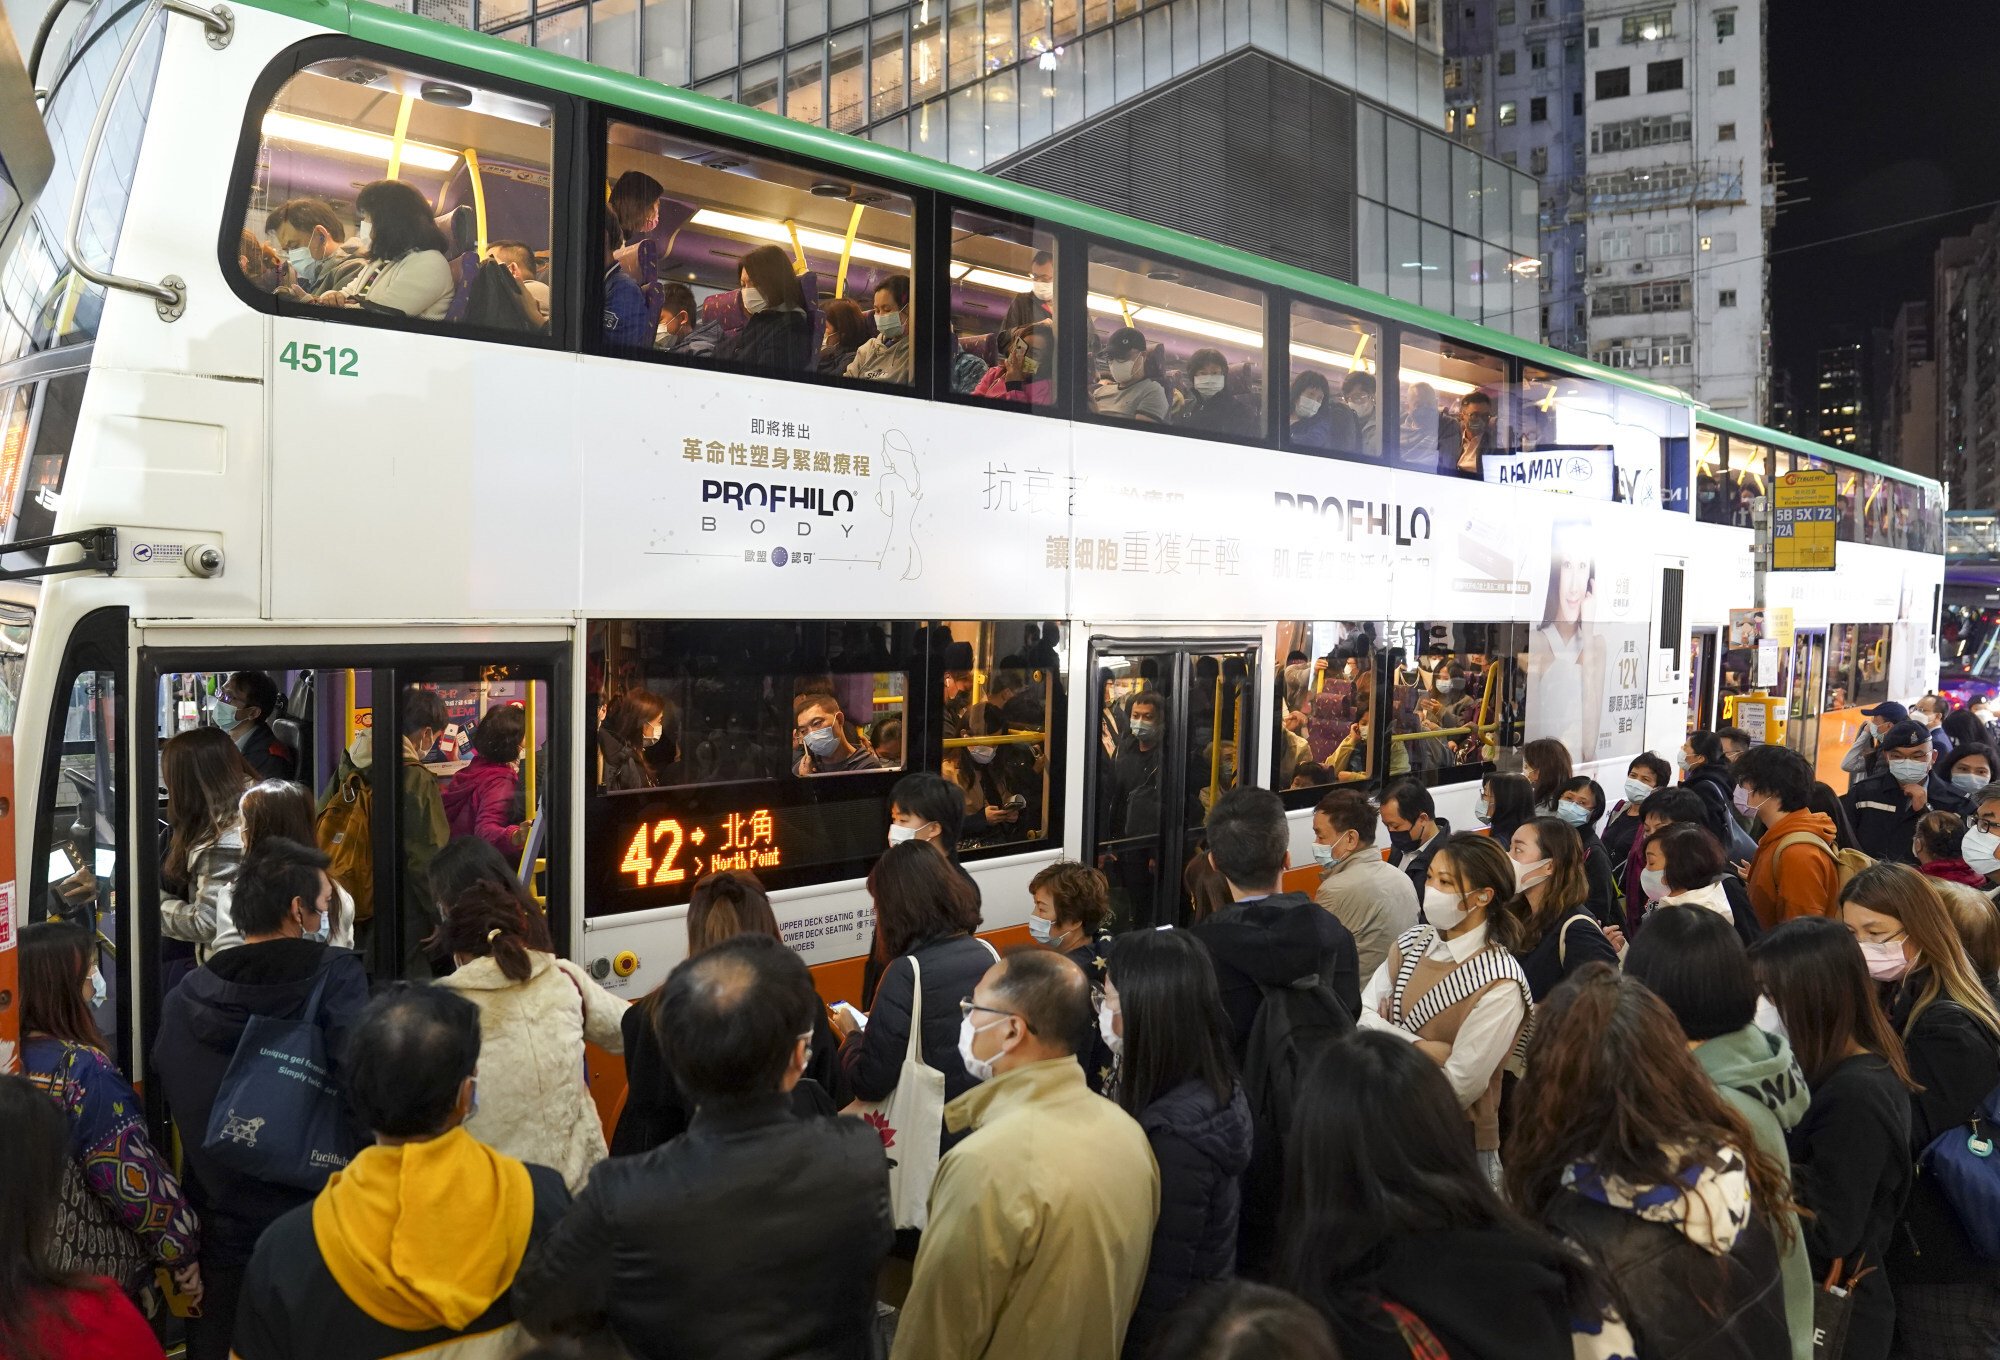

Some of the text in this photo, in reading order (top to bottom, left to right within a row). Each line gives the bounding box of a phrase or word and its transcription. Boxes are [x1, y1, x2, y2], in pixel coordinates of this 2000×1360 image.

[280, 341, 360, 378] 4512
[750, 418, 811, 440] 即將推出
[682, 437, 871, 477] 革命性塑身緊緻療程
[702, 479, 854, 517] PROFHILO
[1776, 507, 1832, 521] 5B 5X 72
[702, 516, 854, 538] BODY
[1776, 524, 1793, 537] 72A
[744, 549, 813, 565] 歐盟 認可
[1618, 657, 1639, 689] 12X
[719, 809, 774, 851] 北角
[620, 818, 686, 887] 42
[711, 846, 781, 874] North Point
[779, 911, 854, 932] UPPER DECK SEATING
[783, 922, 854, 943] OWER DECK SEATING
[259, 1047, 289, 1061] Unique
[289, 1055, 305, 1064] gel
[277, 1066, 308, 1082] Simply
